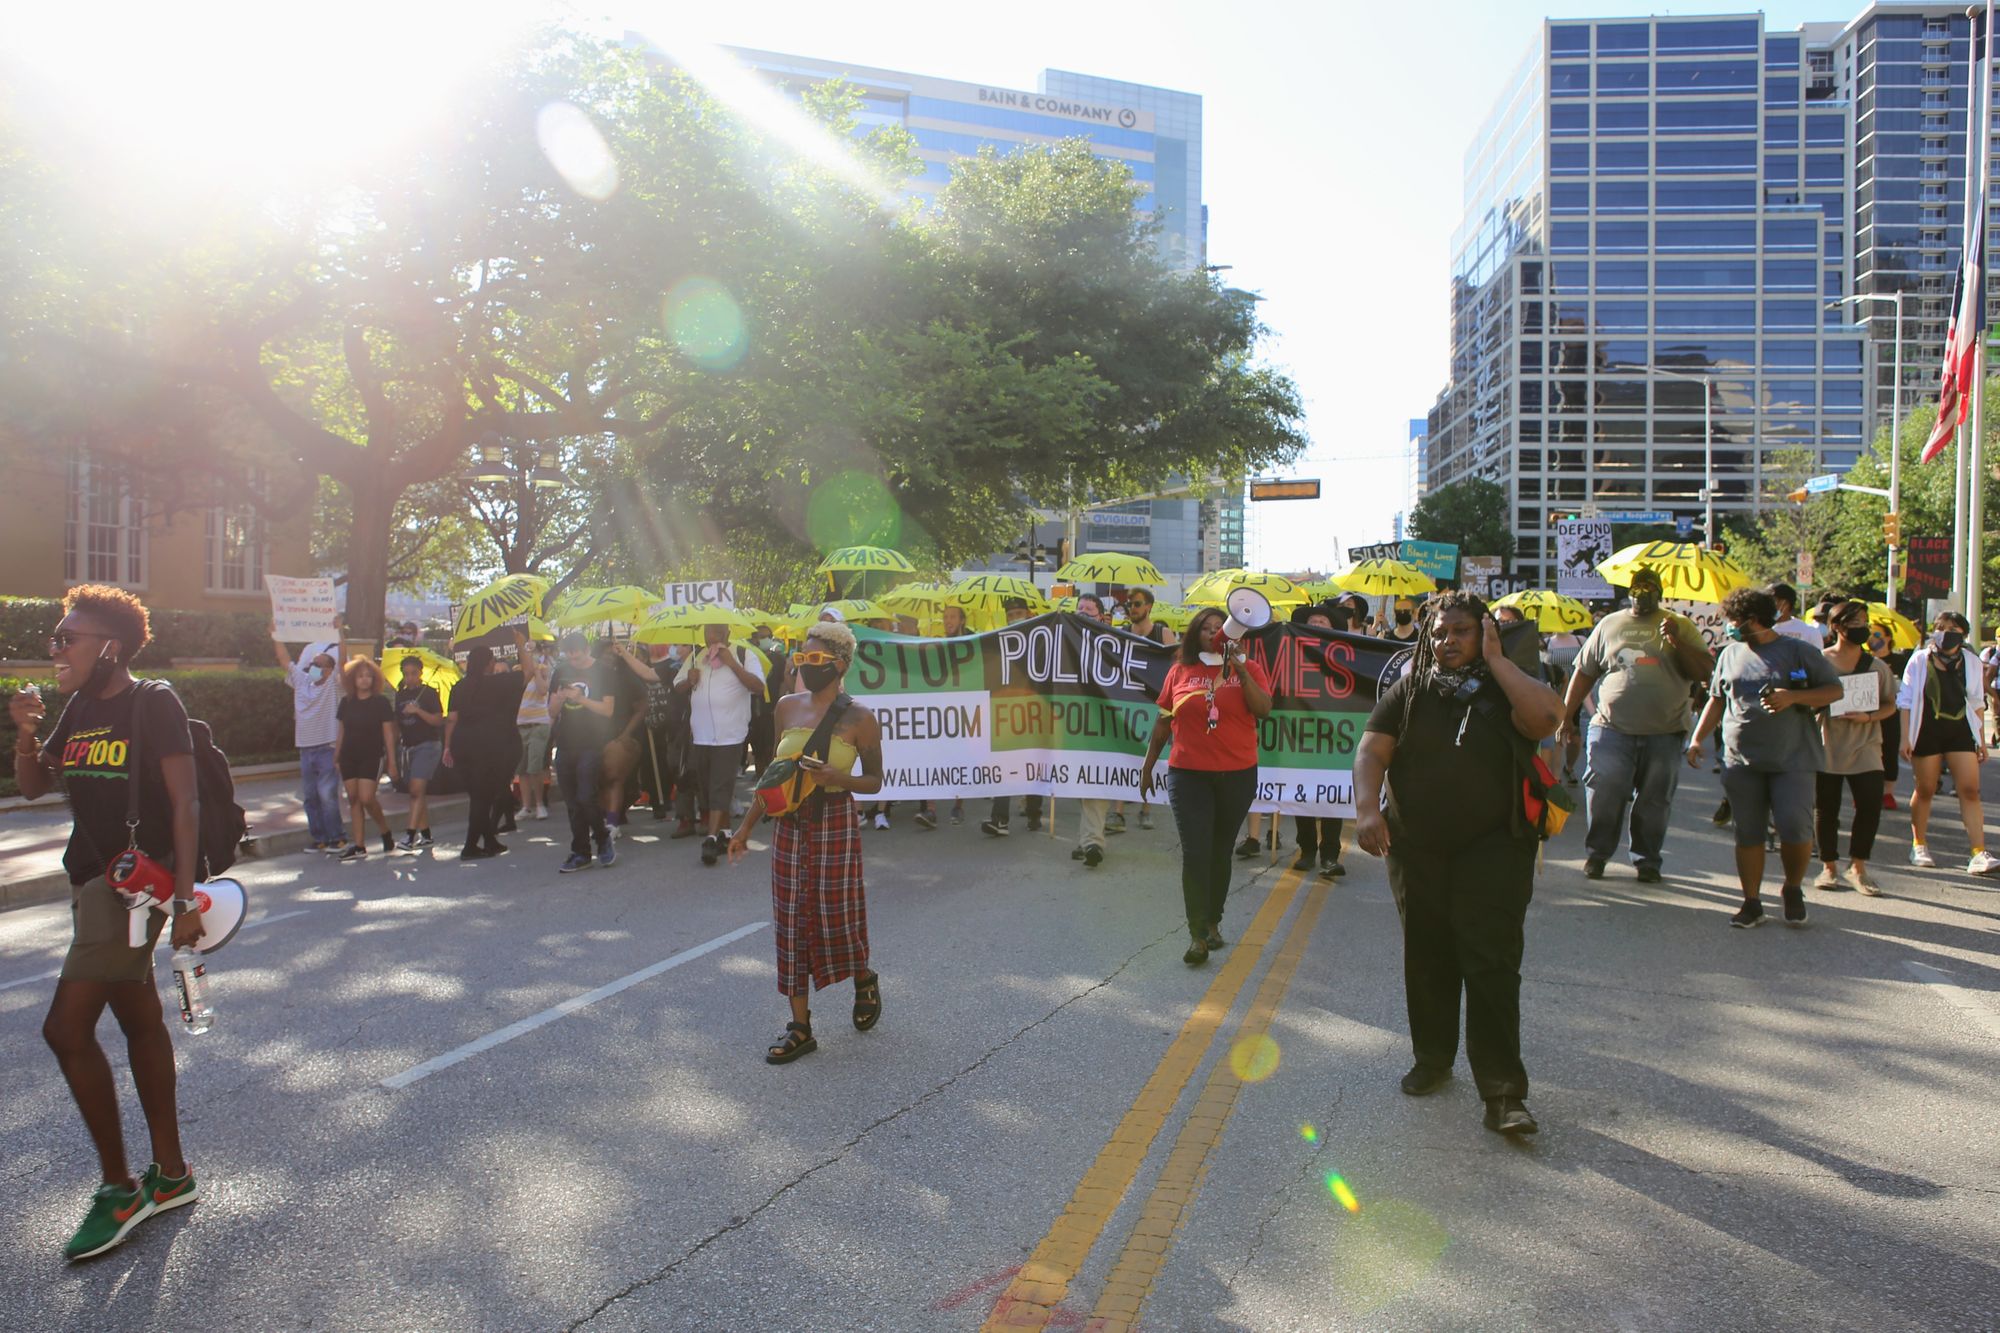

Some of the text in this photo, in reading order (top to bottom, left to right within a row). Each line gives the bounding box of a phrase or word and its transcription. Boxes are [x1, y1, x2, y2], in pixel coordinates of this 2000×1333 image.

[979, 88, 1112, 121] BAIN & COMPANY
[1559, 523, 1611, 535] DEFUND
[1407, 544, 1428, 558] Black
[1911, 538, 1950, 549] BLACK
[1910, 553, 1951, 563] LIVES
[1061, 561, 1120, 581] TONY
[1465, 561, 1501, 576] Silence
[1559, 569, 1578, 578] THE
[671, 581, 733, 606] FUCK
[858, 640, 975, 689] STOP
[998, 624, 1149, 691] POLICE
[872, 705, 981, 740] REEDOM
[995, 702, 1042, 737] FOR
[1051, 702, 1156, 743] POLITIC
[1026, 762, 1069, 784] DALLAS
[1294, 784, 1307, 803] &
